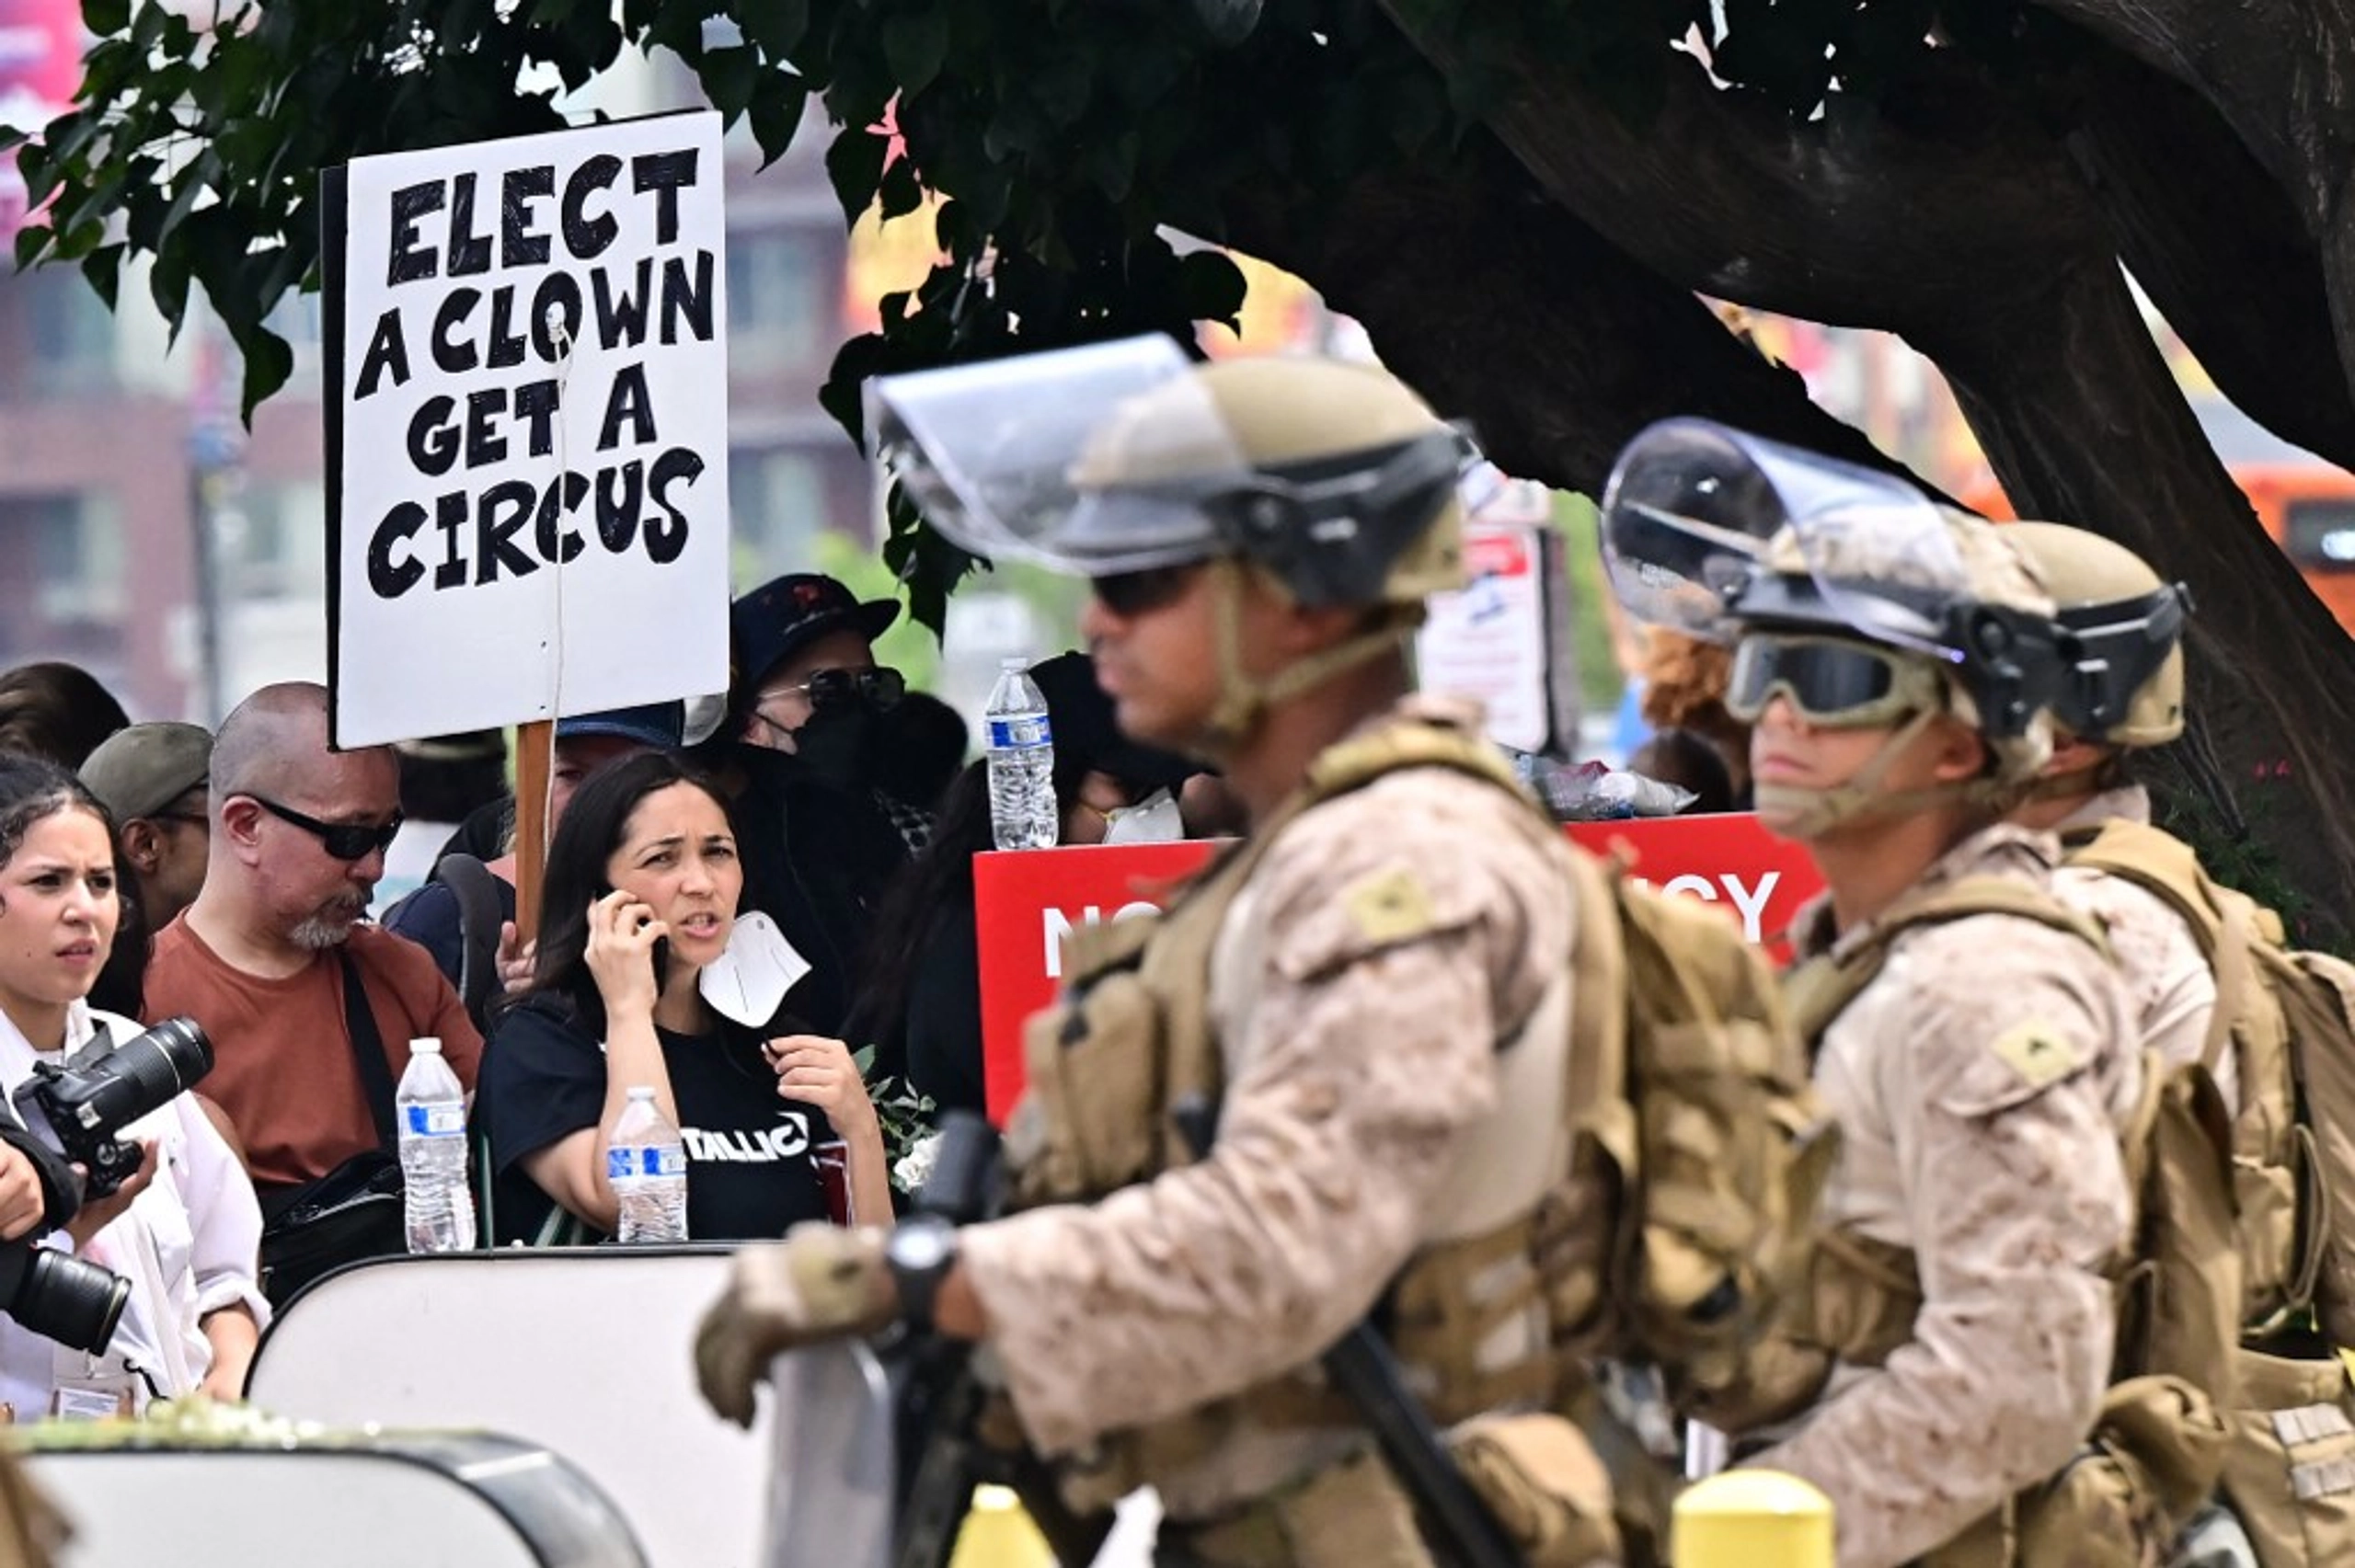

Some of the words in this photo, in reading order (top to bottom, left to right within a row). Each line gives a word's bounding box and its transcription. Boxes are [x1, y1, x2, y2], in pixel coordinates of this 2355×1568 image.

[387, 147, 699, 288] ELECT
[354, 307, 410, 401] A
[431, 249, 714, 373] CLOWN
[407, 379, 566, 476] GET
[596, 361, 657, 452] A
[367, 447, 705, 599] CIRCUS
[680, 1111, 808, 1162] TALLIC
